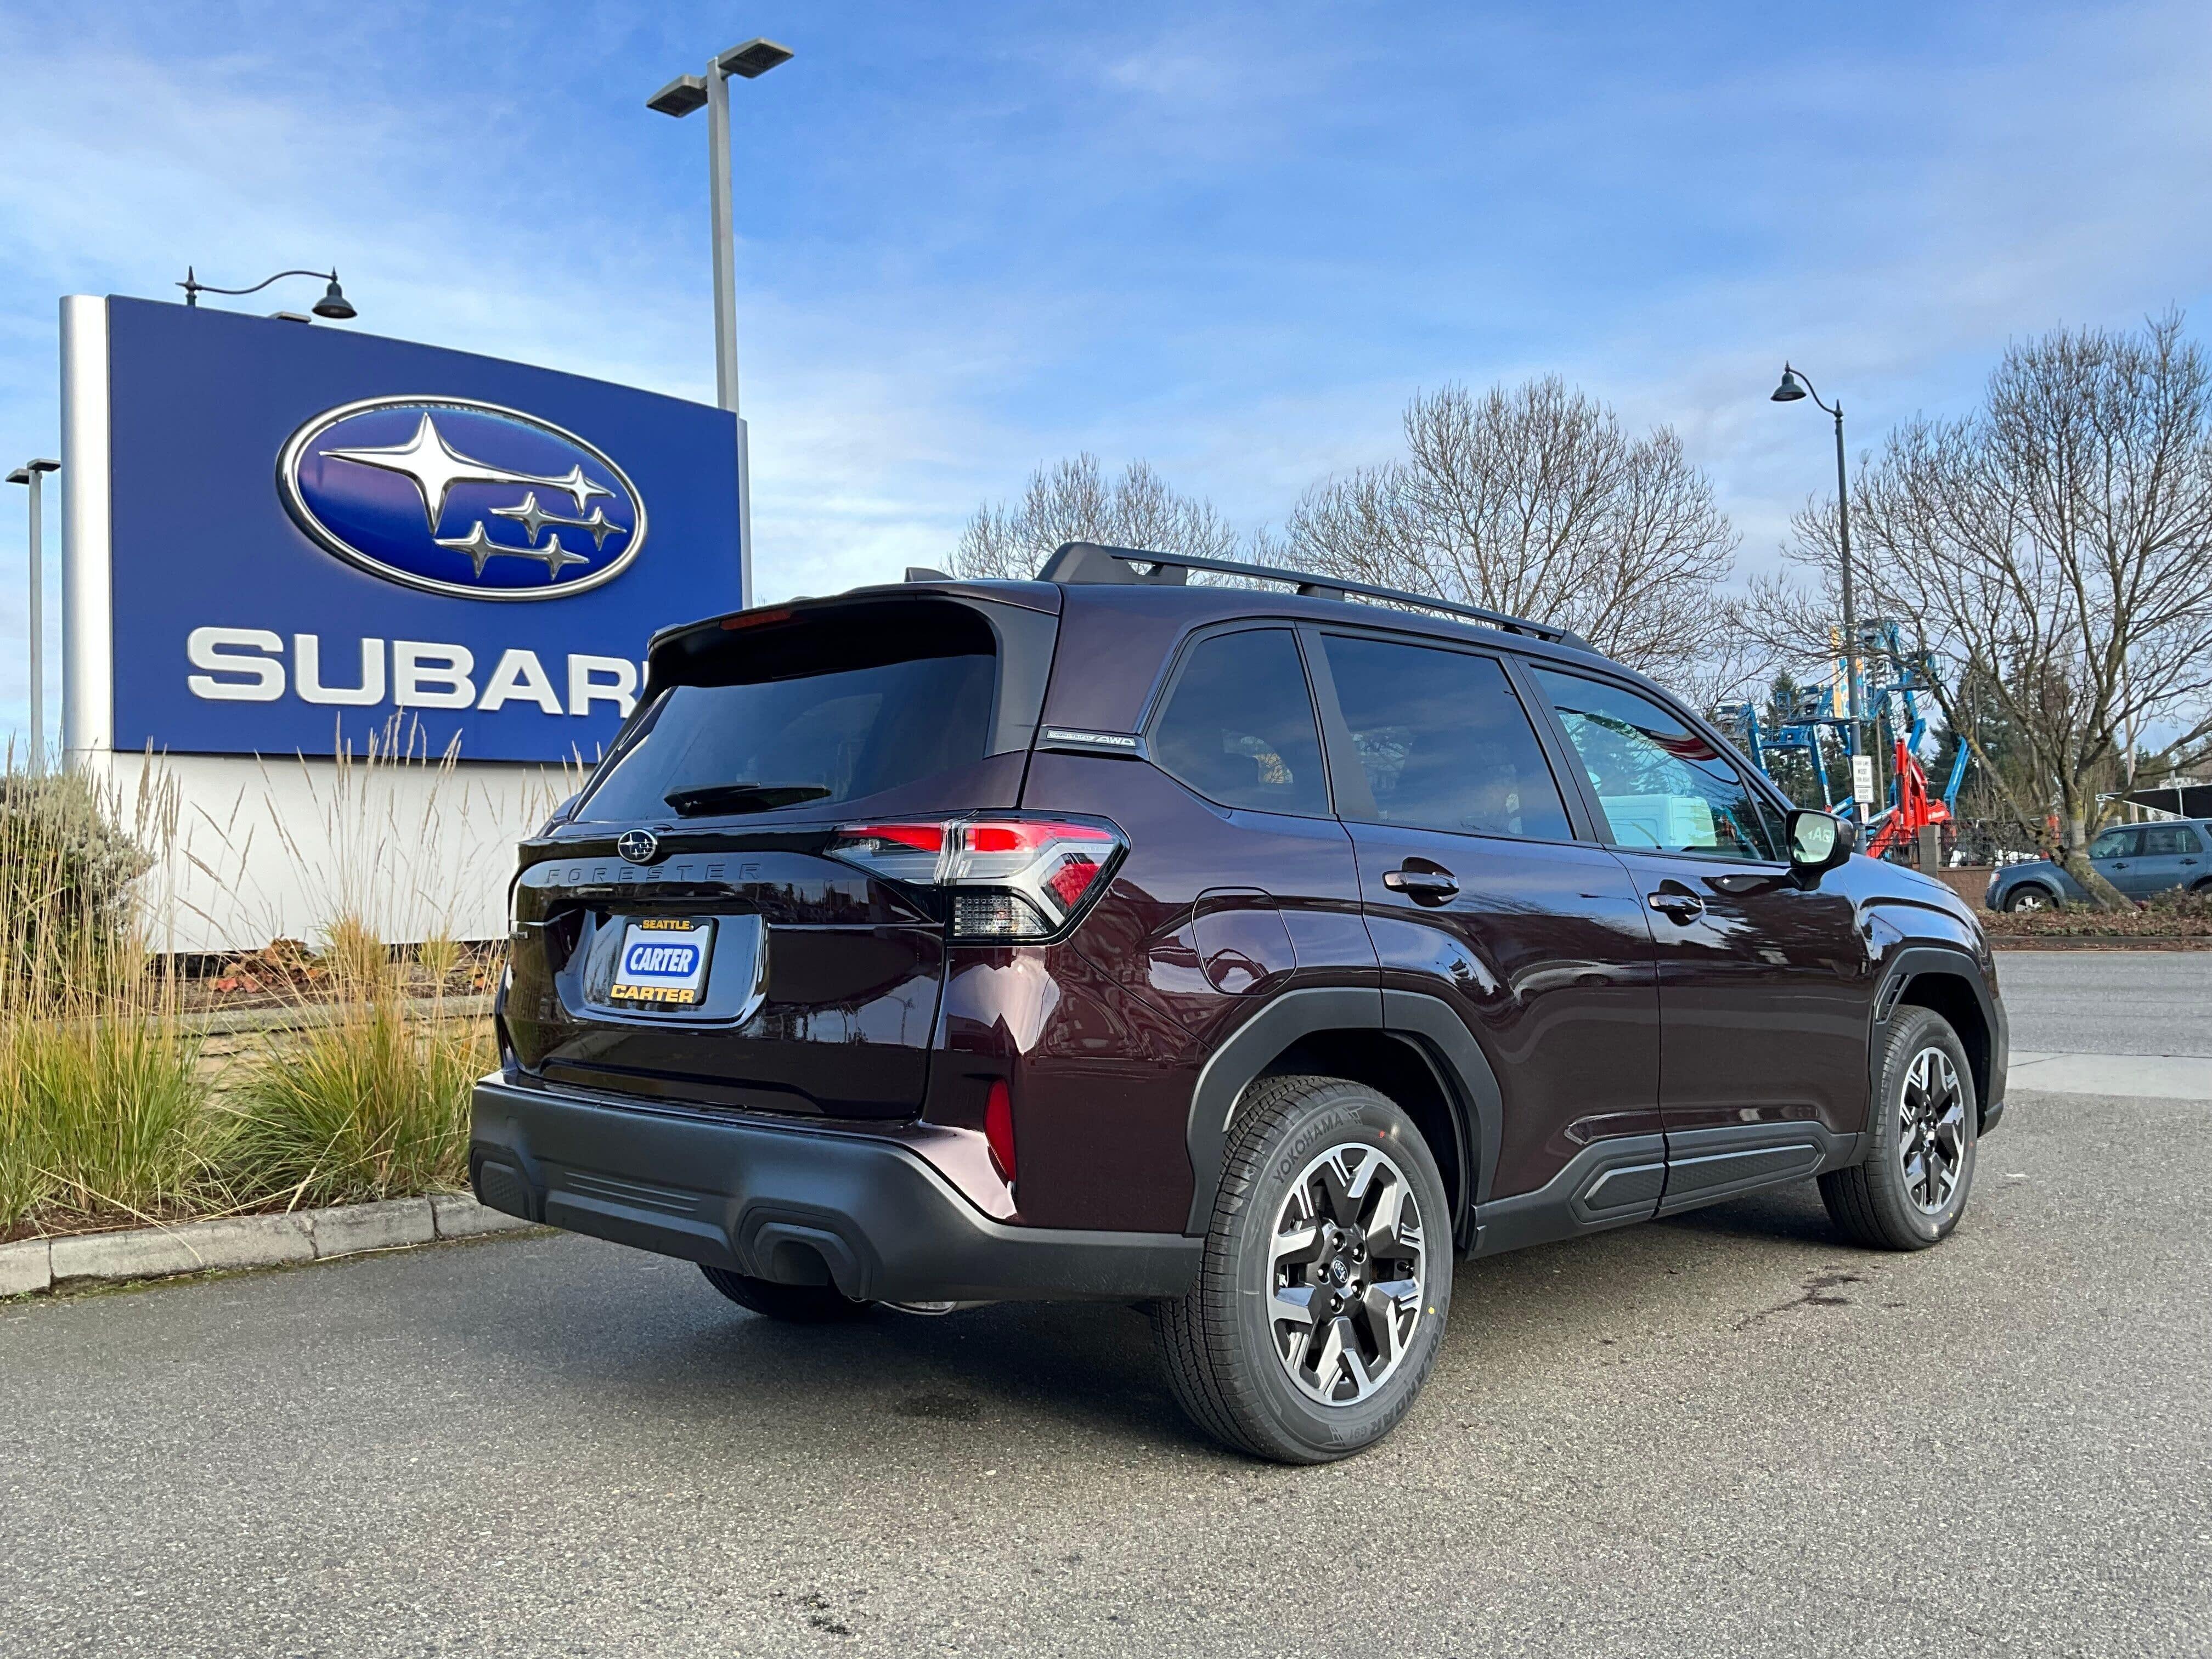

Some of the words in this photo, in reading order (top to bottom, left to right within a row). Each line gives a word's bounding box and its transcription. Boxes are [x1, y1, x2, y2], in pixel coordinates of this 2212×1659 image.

[187, 626, 650, 718] SUBAR
[1096, 736, 1135, 746] AWD
[546, 863, 762, 883] FORESTER
[642, 919, 691, 930] SEATTLE
[630, 947, 693, 973] CARTER
[610, 984, 695, 1003] CARTER
[1273, 1111, 1344, 1184] YOKOHAMA
[1369, 1295, 1447, 1434] GEOLANDAR
